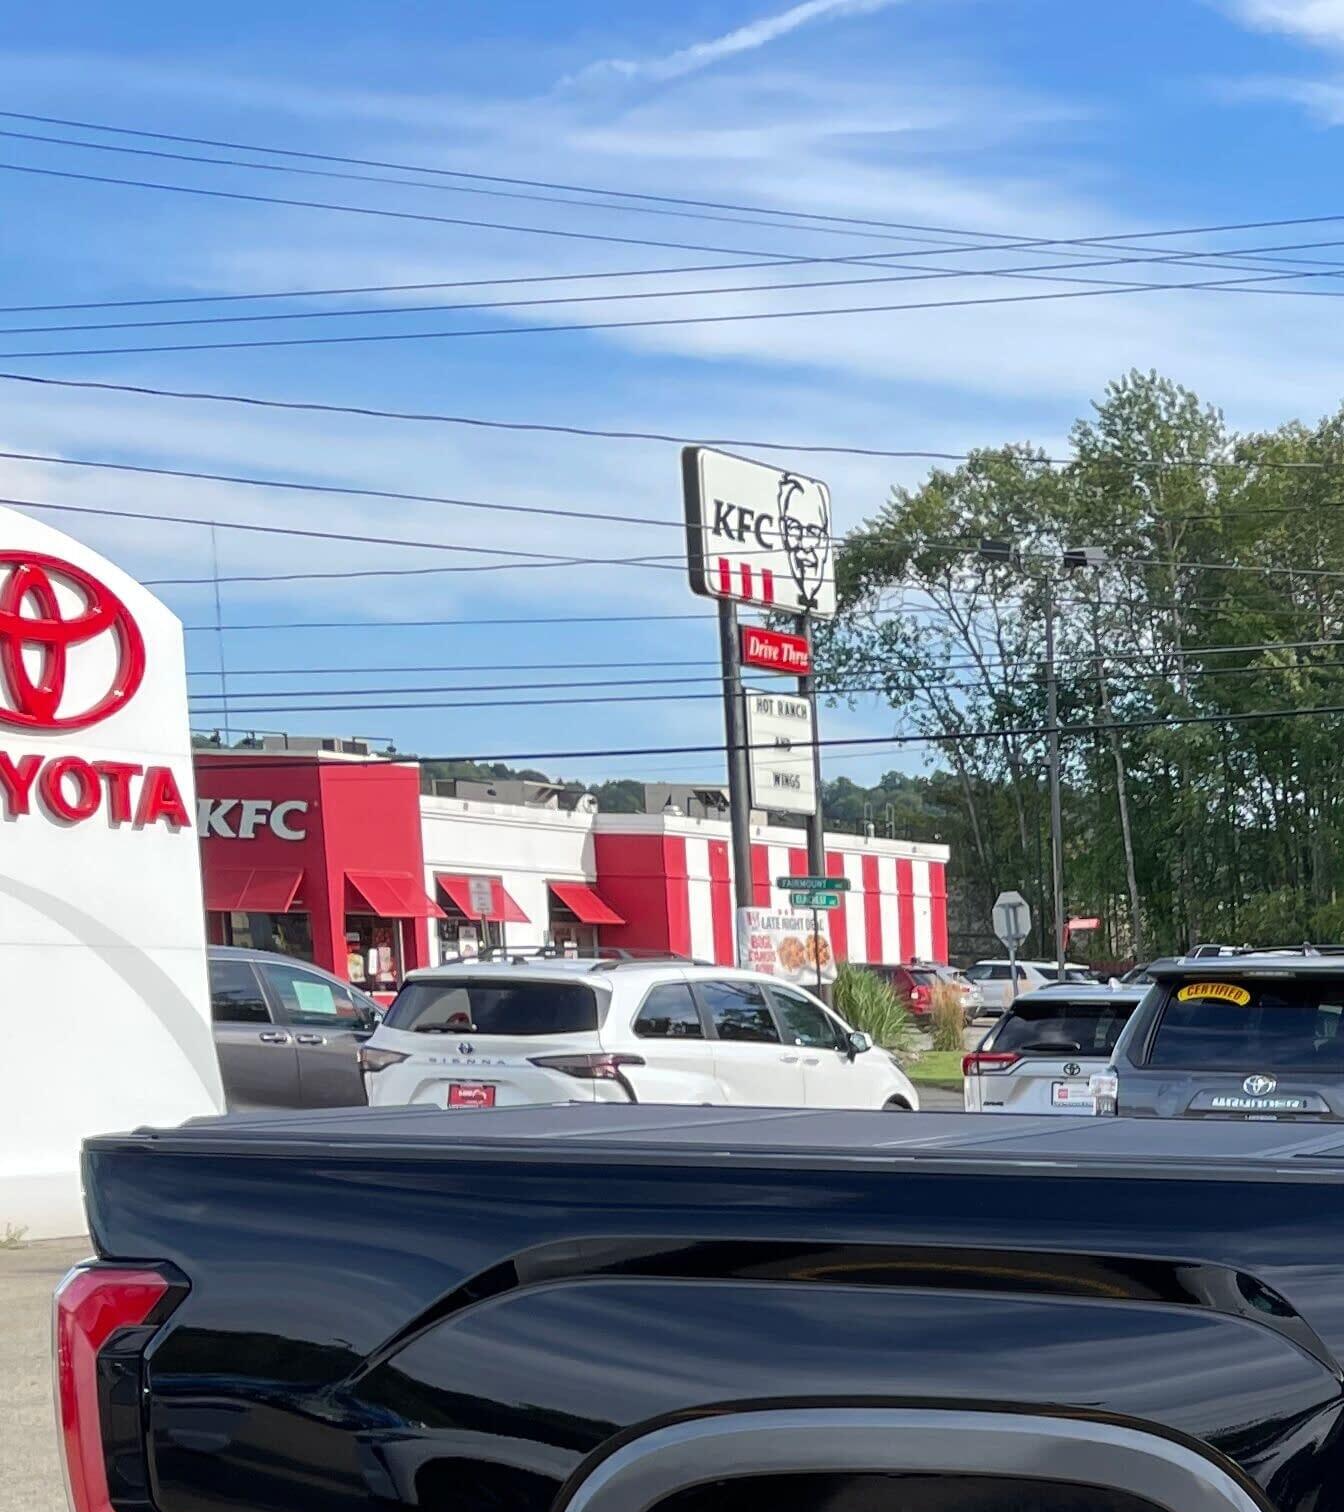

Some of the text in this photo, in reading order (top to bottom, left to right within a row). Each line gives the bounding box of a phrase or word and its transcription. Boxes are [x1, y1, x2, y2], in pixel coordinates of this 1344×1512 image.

[712, 499, 773, 550] KFC
[750, 636, 808, 666] Drive Thru
[756, 697, 807, 719] HOT RANCH
[773, 772, 801, 789] WINGS
[199, 798, 309, 841] KFC
[1187, 984, 1243, 1001] CERTIFIED
[428, 1057, 507, 1065] SIENNA
